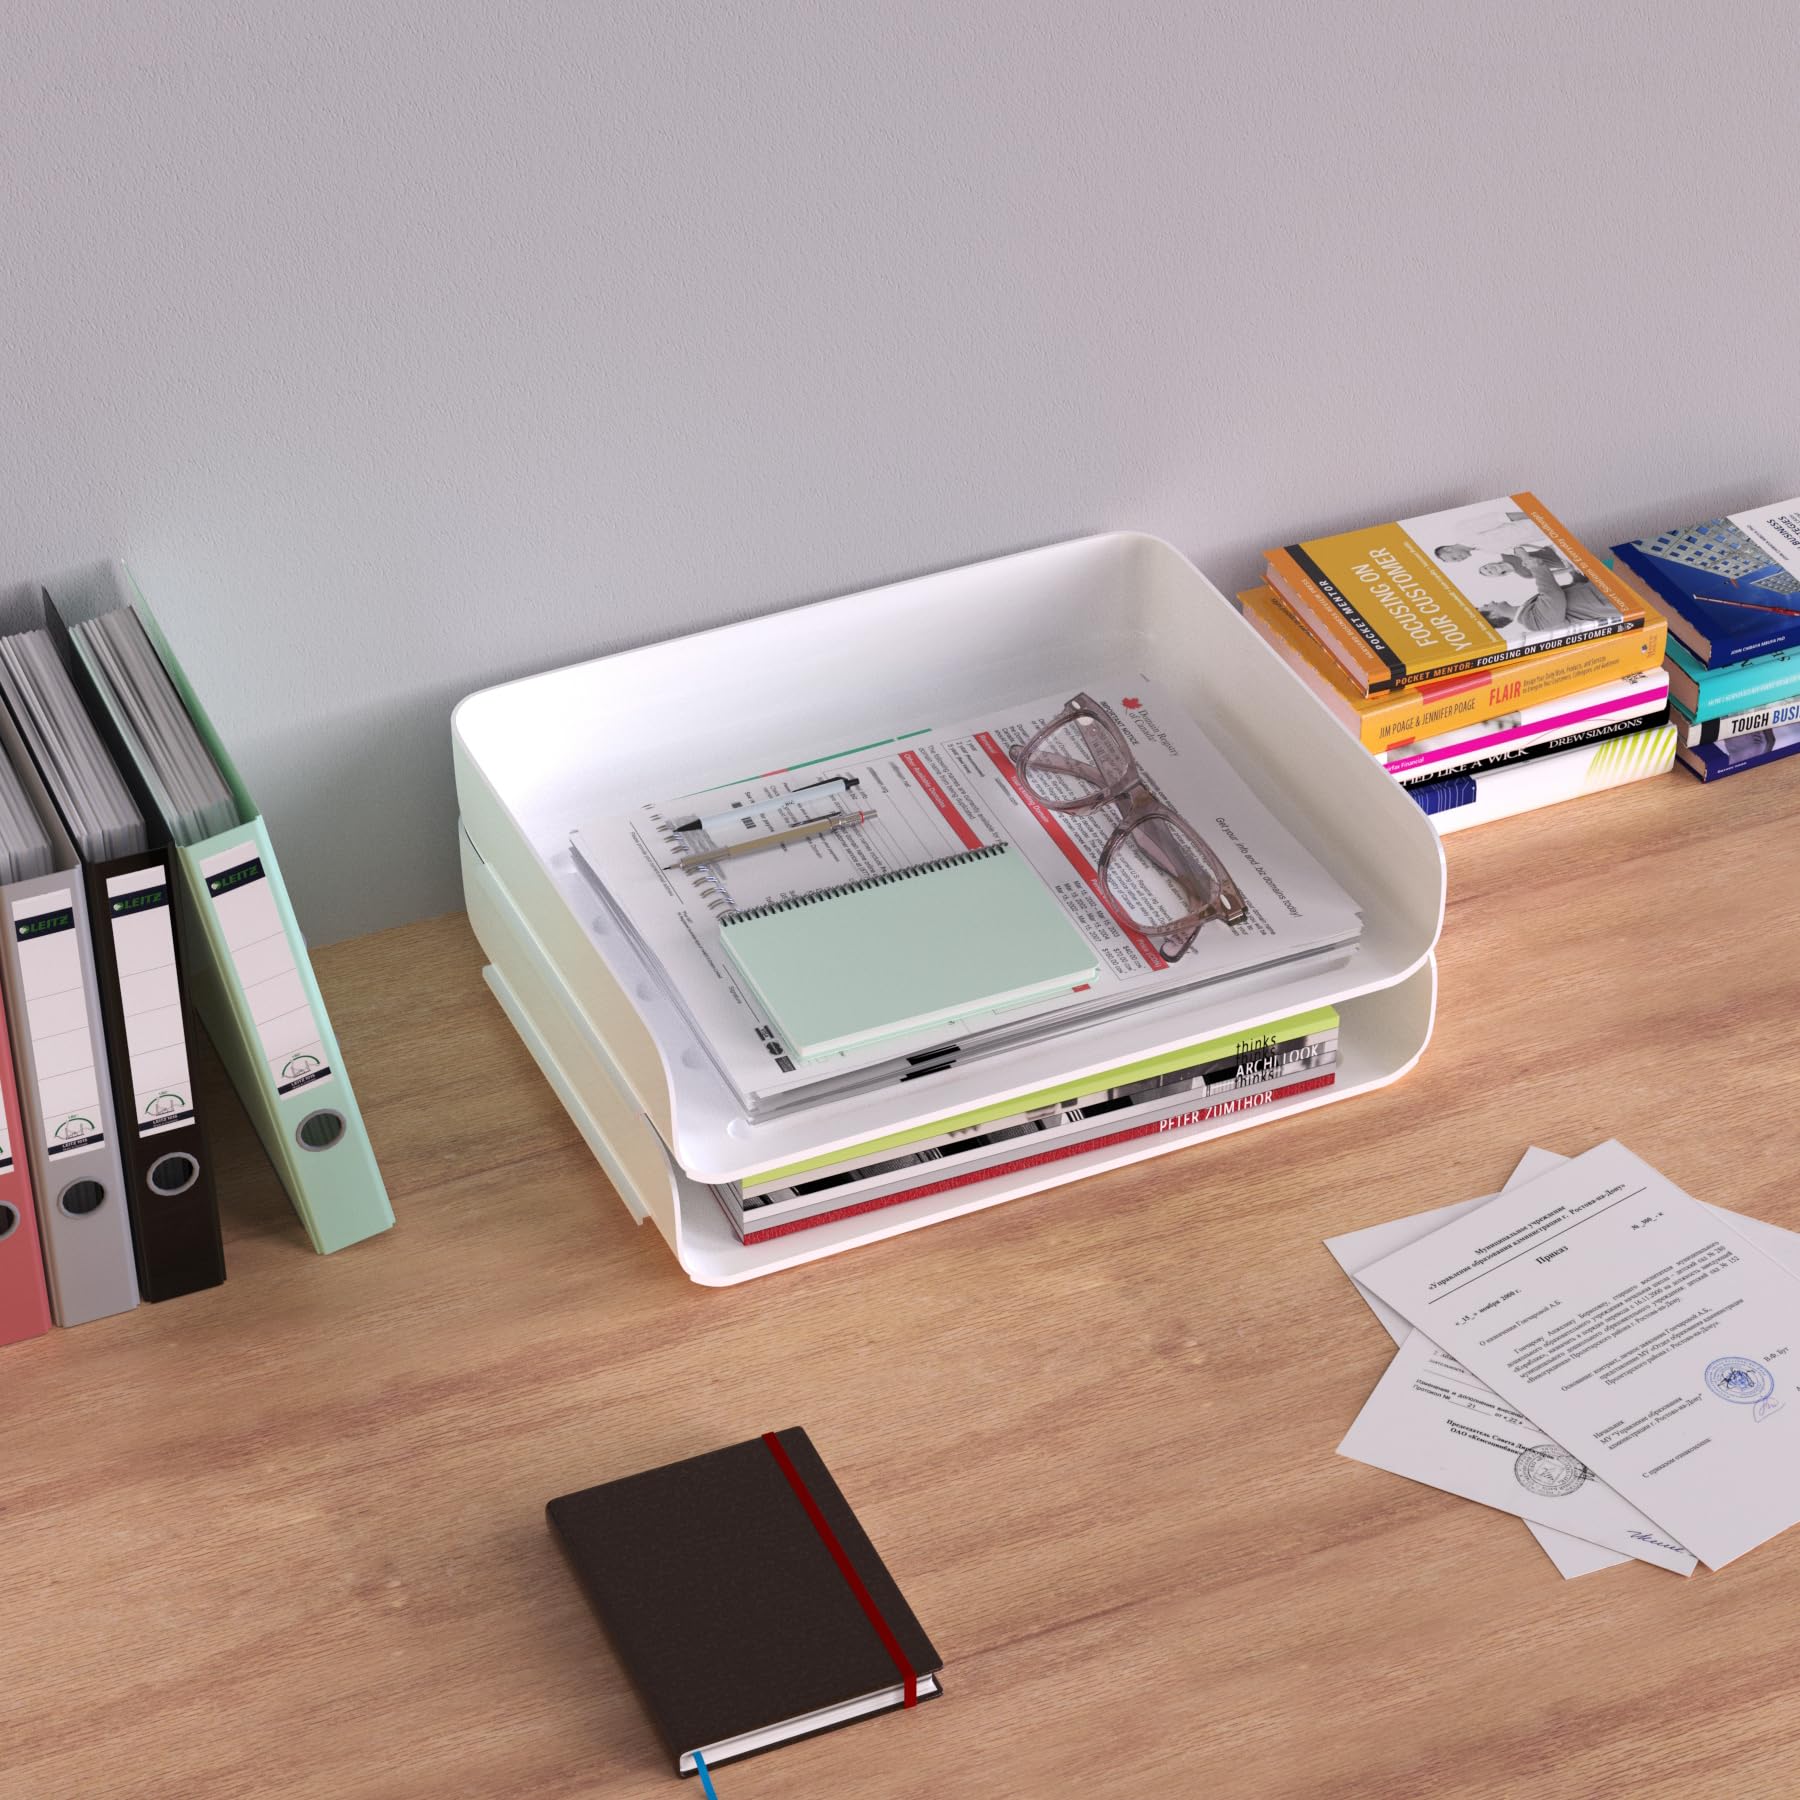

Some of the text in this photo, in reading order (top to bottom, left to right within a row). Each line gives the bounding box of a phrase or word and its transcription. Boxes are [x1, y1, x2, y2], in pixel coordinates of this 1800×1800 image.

[1766, 519, 1800, 546] BUSINESS
[1777, 516, 1800, 536] TEGIES
[1369, 547, 1441, 614] CUSTOMER
[1319, 580, 1385, 650] POCKET MENTOR
[1351, 563, 1439, 647] FOCUSING ON
[1430, 614, 1472, 652] YOUR
[1477, 649, 1521, 667] FOCUSING
[1539, 638, 1563, 652] YOUR
[1565, 627, 1613, 646] CUSTOMER
[1396, 661, 1474, 689] POCKET MENTOR:
[1488, 680, 1522, 707] FLAIR
[1100, 701, 1139, 746] IMPORTANT NOTICE
[1137, 709, 1160, 737] Domain
[1379, 725, 1391, 739] JIM
[1392, 717, 1414, 735] POAGE
[1421, 705, 1453, 726] JENNIFER
[1453, 698, 1476, 715] POAGE
[1731, 712, 1769, 734] TOUGH
[1548, 717, 1643, 751] DREW SIMMONS
[1400, 756, 1425, 768] Financial
[1487, 748, 1530, 765] WICK
[1215, 817, 1229, 832] Get
[1222, 828, 1239, 841] your
[222, 864, 259, 887] LEITZ
[124, 890, 162, 910] LEITZ
[30, 914, 69, 933] LEITZ
[1235, 1034, 1277, 1054] thinks
[1159, 1091, 1273, 1132] PETER ZUMTHOR
[1535, 1246, 1569, 1264] Приказ
